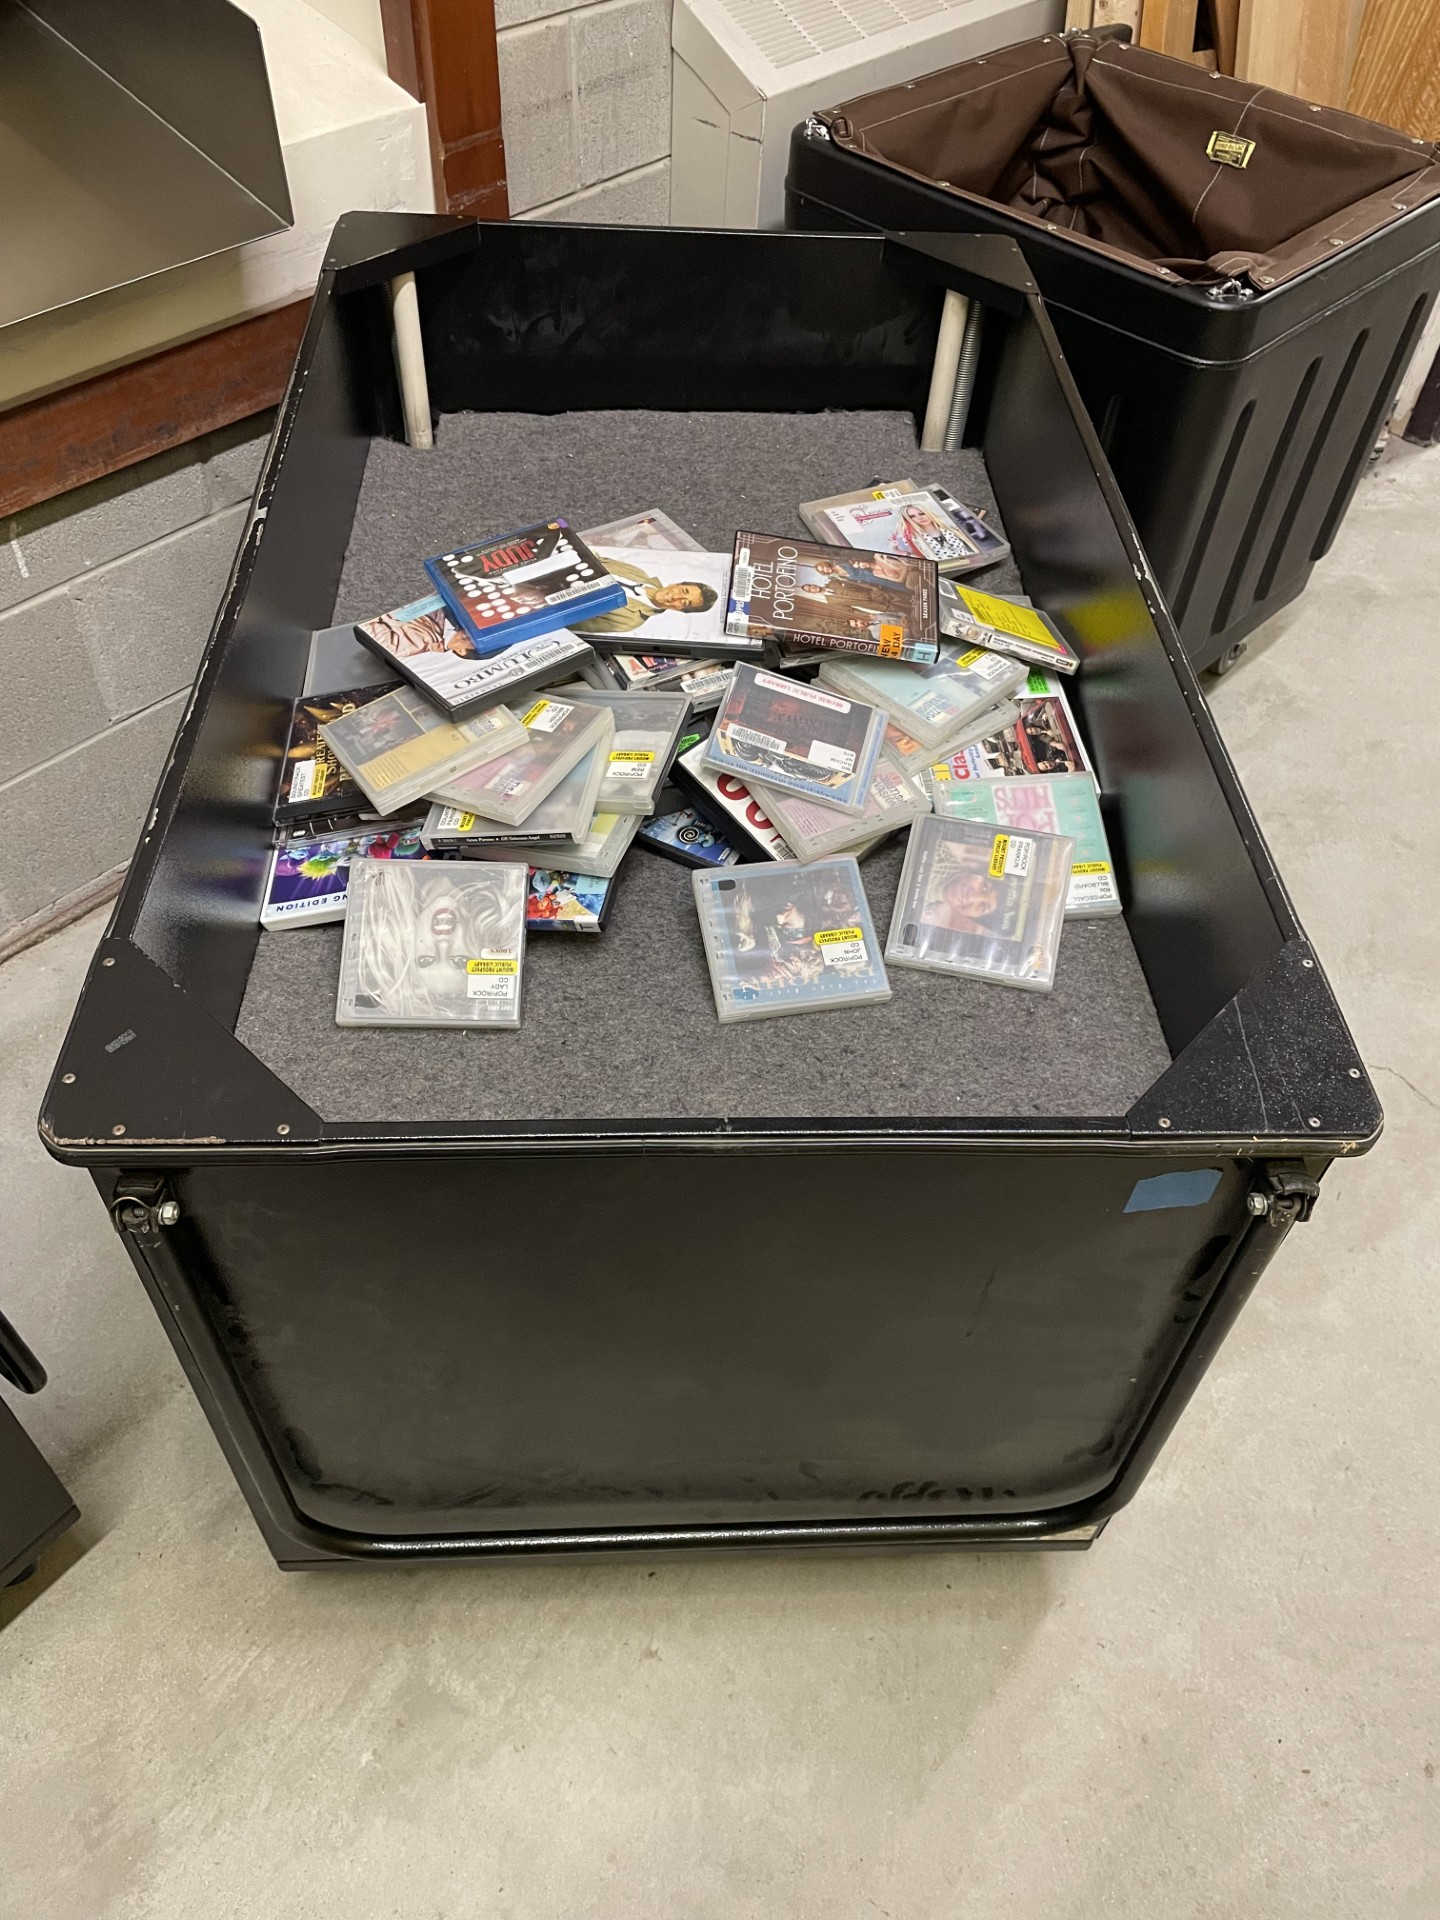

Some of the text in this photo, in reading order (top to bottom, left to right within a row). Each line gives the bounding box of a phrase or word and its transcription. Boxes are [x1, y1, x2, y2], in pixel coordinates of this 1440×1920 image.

[481, 540, 537, 573] JUDY
[750, 562, 773, 599] HOTEL
[773, 546, 798, 620] PORTOFINO
[793, 634, 879, 653] HOTEL PORTOFI
[454, 640, 560, 689] LUMBO
[762, 678, 790, 691] LIBRARY
[792, 688, 816, 699] PUBLIC
[953, 751, 971, 779] Cla
[997, 854, 1005, 873] PROSPECT
[1015, 841, 1023, 867] FRANKLIN
[1021, 842, 1030, 869] POP/ROCK
[276, 898, 327, 911] EDITION
[830, 954, 862, 963] POP/ROCK
